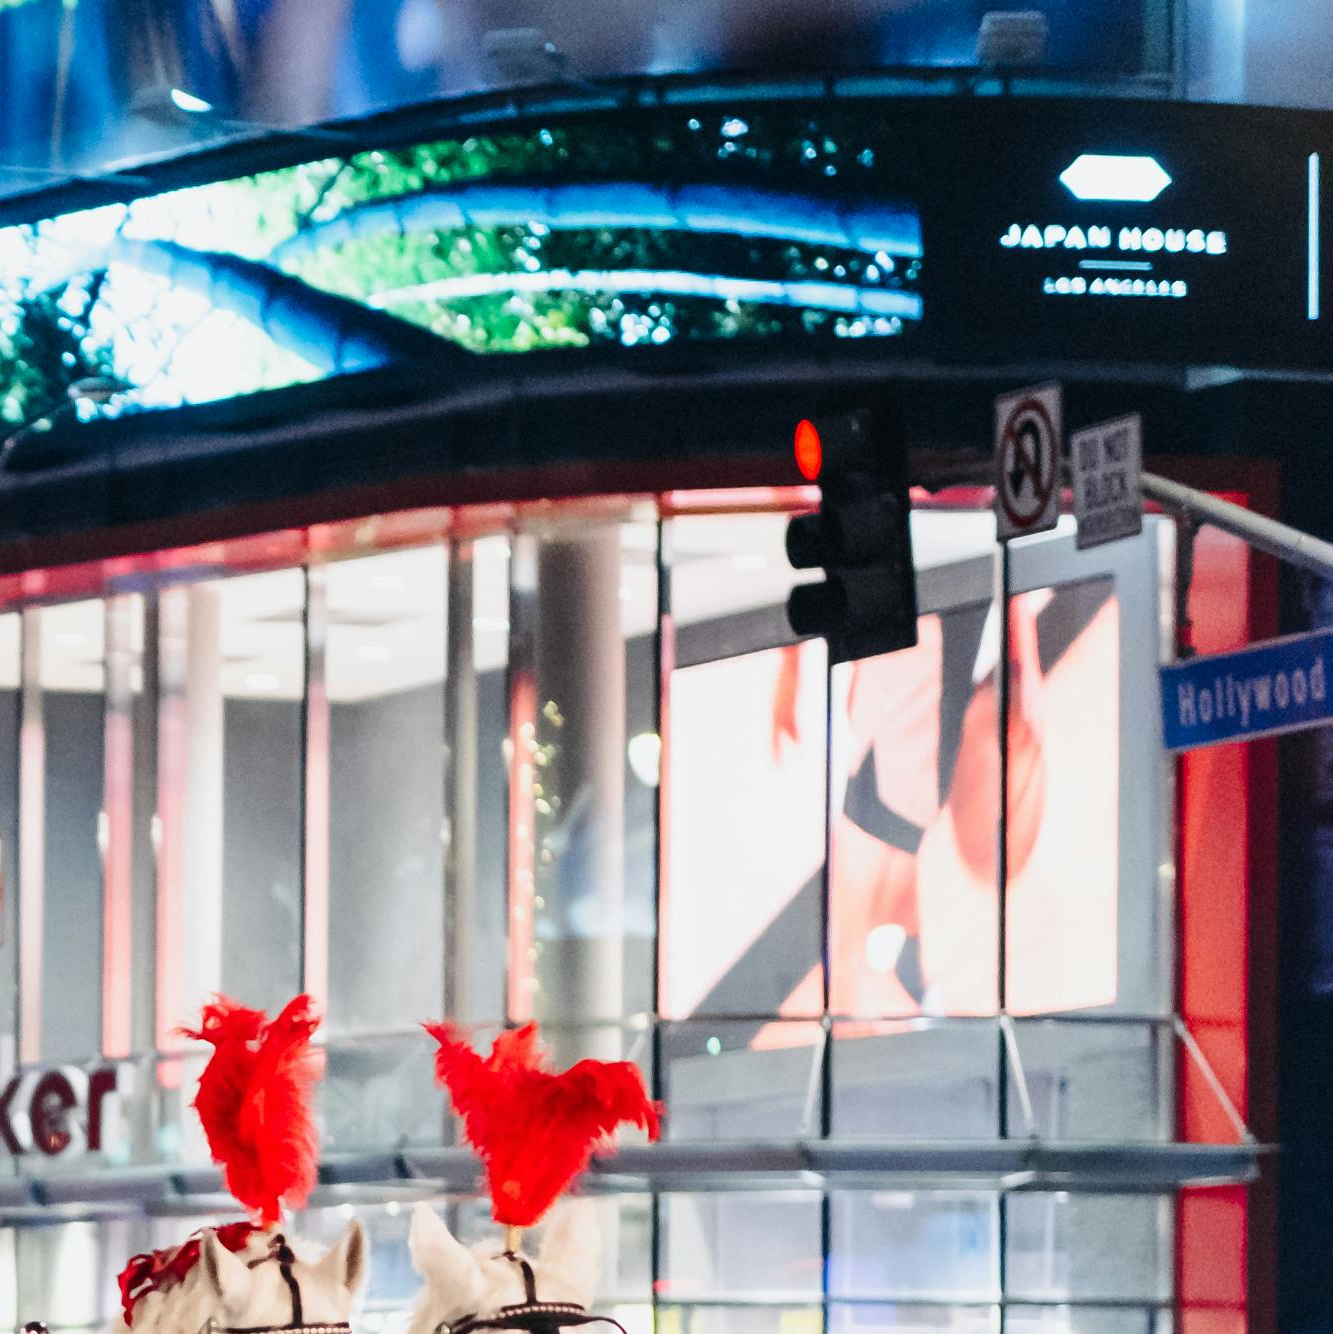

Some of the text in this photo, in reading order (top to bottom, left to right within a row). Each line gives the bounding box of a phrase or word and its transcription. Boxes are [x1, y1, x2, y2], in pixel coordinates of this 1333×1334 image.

[999, 223, 1227, 254] JAPAN HOUSE
[1177, 655, 1326, 728] Hollywood
